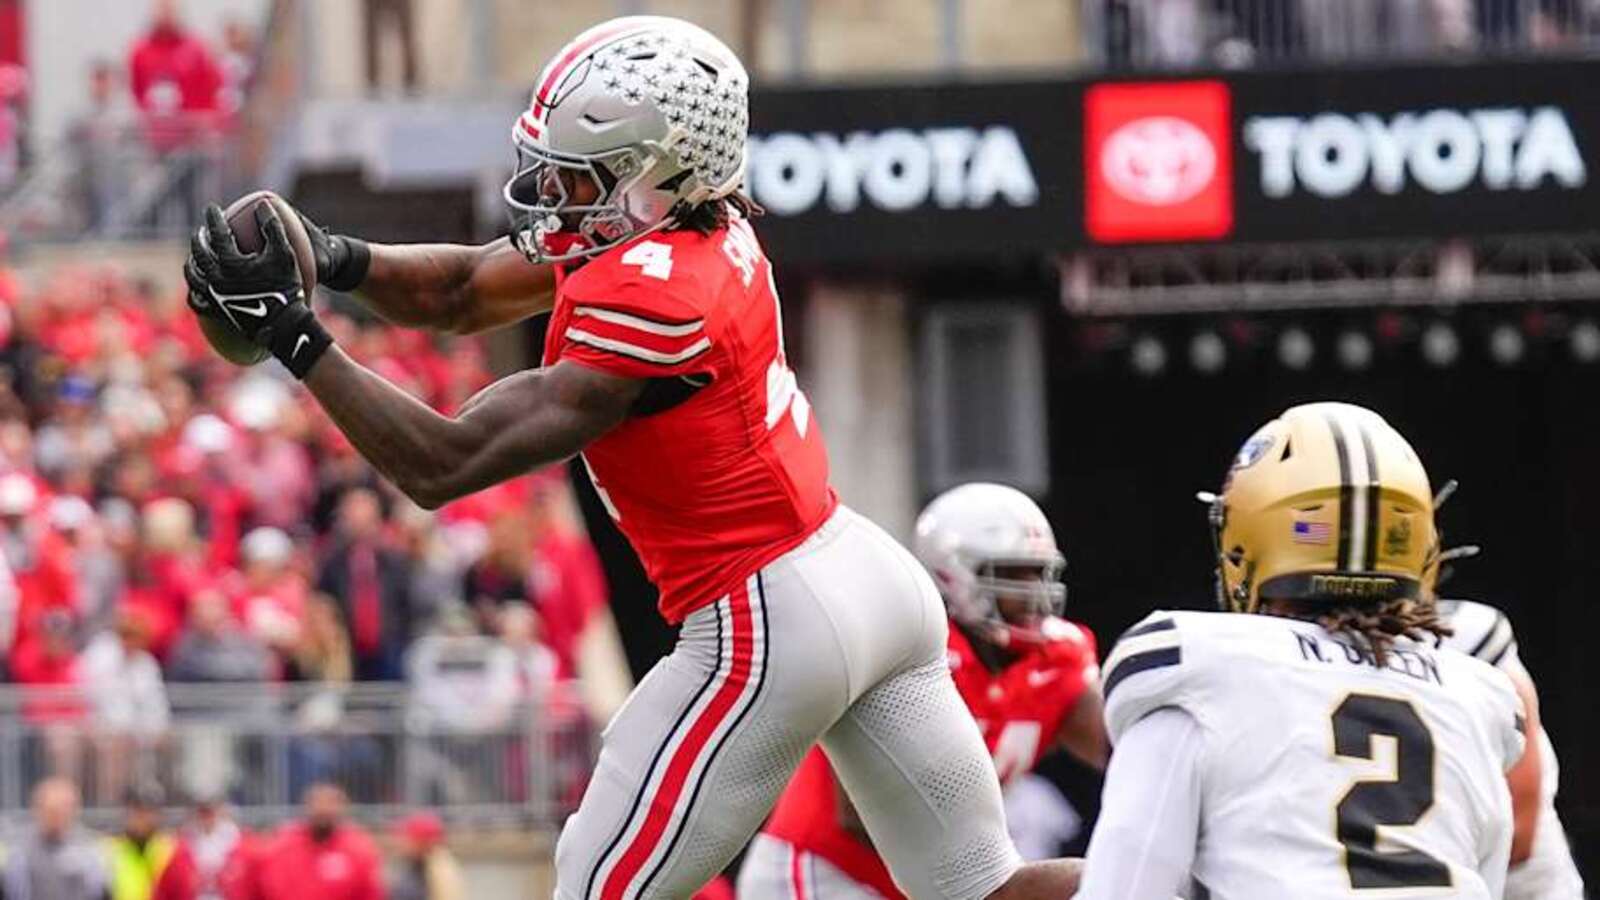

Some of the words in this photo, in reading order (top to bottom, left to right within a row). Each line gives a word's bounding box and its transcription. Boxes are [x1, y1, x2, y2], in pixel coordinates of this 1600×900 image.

[747, 126, 1040, 215] OYOTA
[1244, 105, 1586, 198] TOYOTA
[621, 241, 673, 281] 4
[1330, 691, 1455, 891] 2
